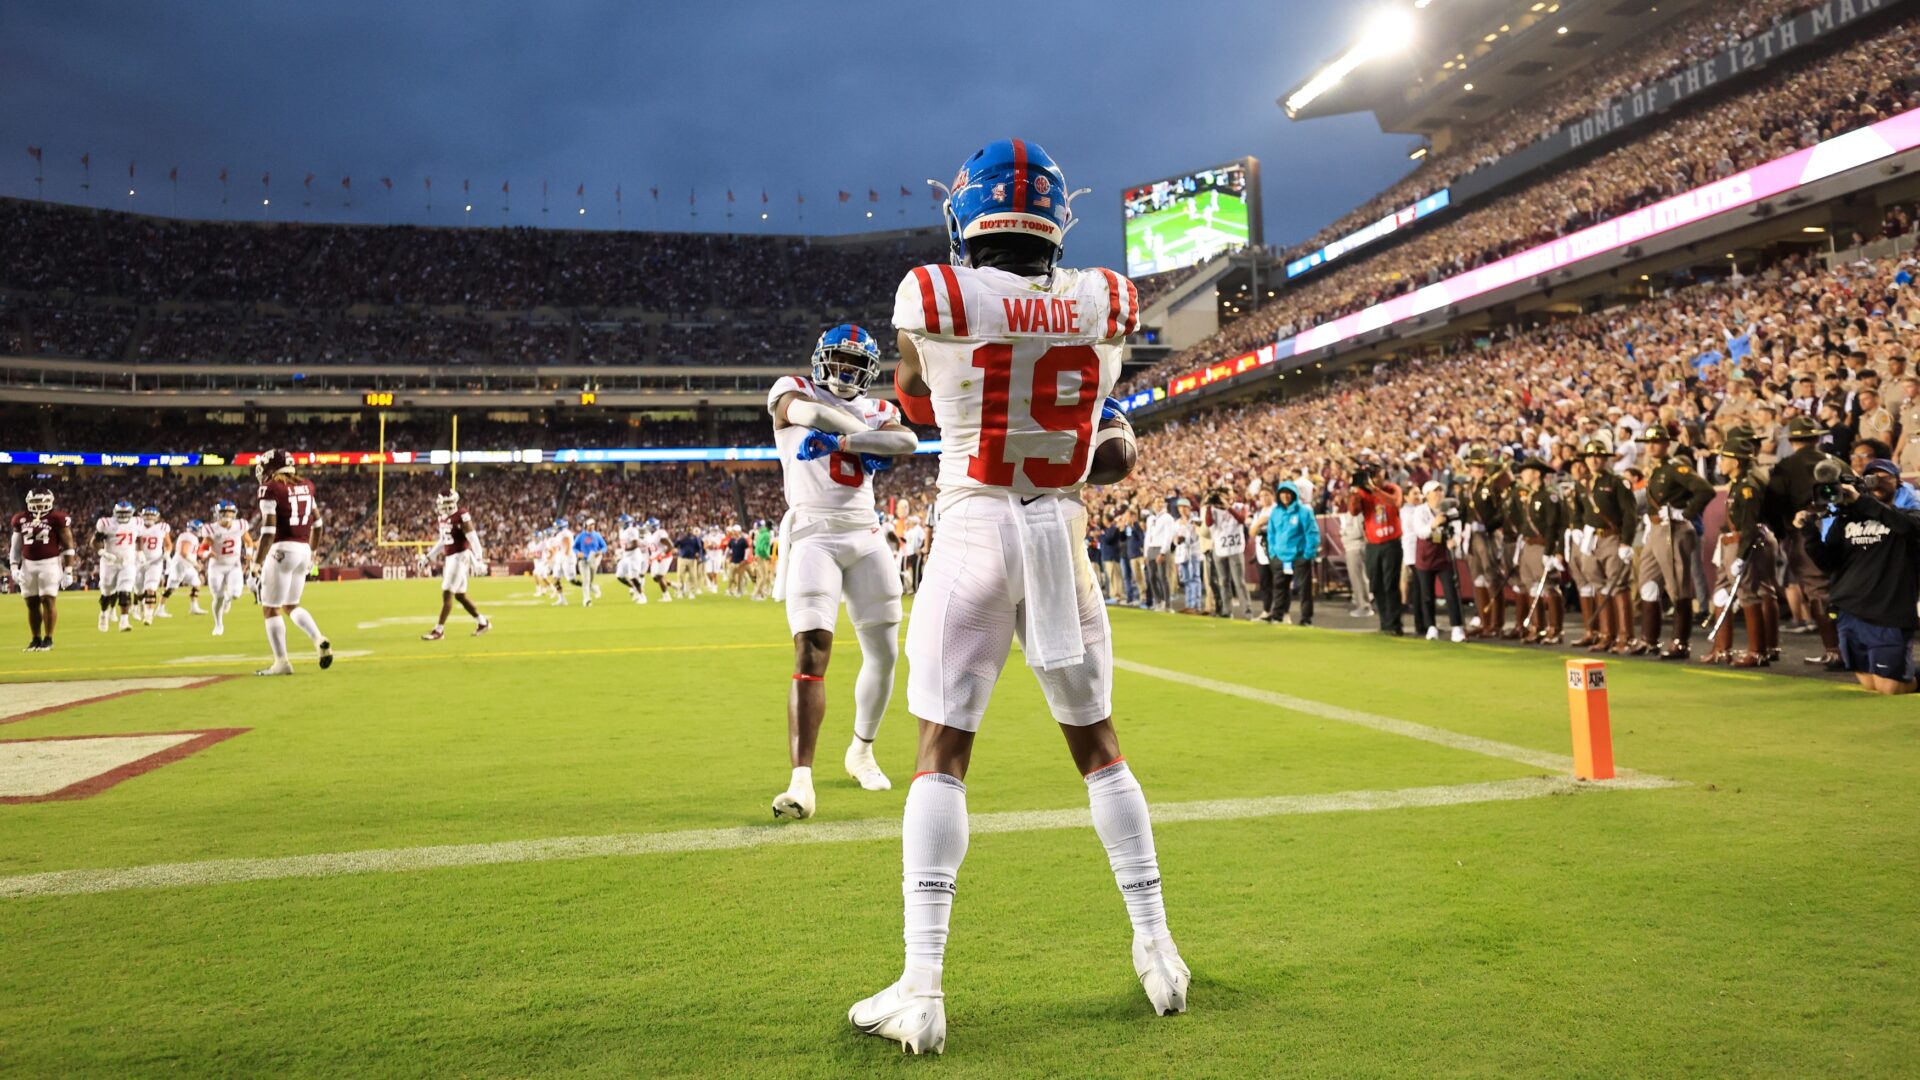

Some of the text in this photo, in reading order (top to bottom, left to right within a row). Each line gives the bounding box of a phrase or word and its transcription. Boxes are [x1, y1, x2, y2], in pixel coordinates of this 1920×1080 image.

[1569, 104, 1624, 148] HOME
[1632, 87, 1658, 118] OF
[1669, 59, 1717, 100] THE
[1729, 20, 1798, 74] 12TH
[979, 219, 1055, 235] HOTTY TODDY
[1002, 297, 1081, 333] WADE
[967, 343, 1100, 488] 19
[288, 494, 312, 526] 17
[21, 527, 50, 545] 24
[115, 533, 133, 546] 71
[1220, 533, 1242, 548] 232
[221, 539, 235, 555] 2
[382, 566, 407, 579] GIG
[918, 880, 948, 888] NIKE
[1121, 881, 1145, 890] NIKE
